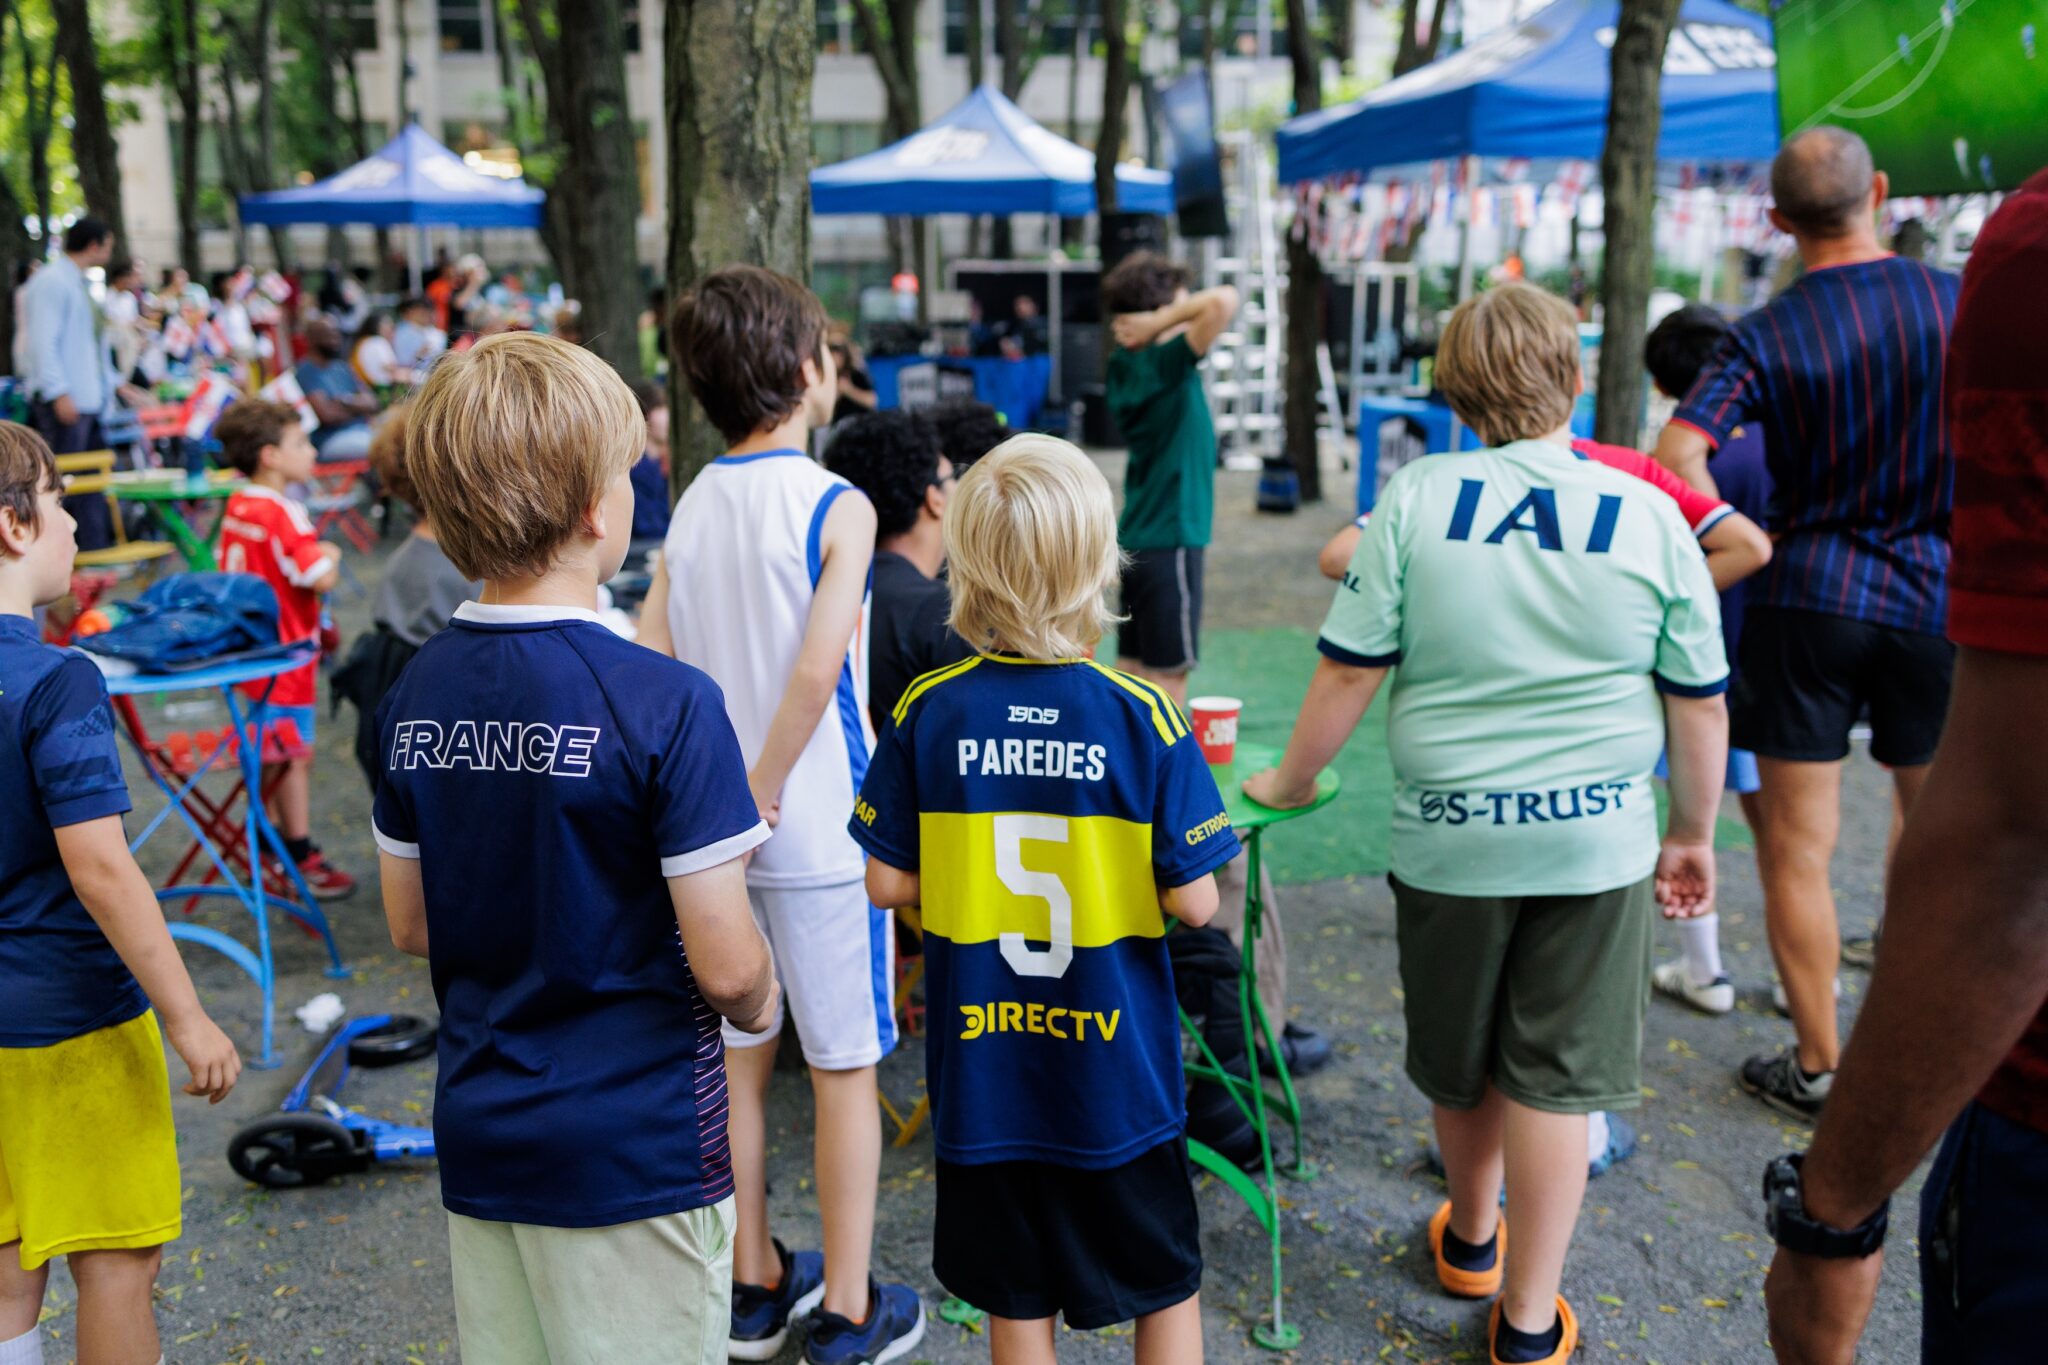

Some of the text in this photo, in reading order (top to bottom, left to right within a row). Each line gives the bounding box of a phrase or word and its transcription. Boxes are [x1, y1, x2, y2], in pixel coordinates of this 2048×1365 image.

[1446, 479, 1623, 553] IAI
[1007, 705, 1060, 725] 1905
[389, 720, 601, 778] FRANCE
[957, 738, 1107, 782] PAREDES
[993, 814, 1074, 979] 5
[959, 1001, 1121, 1042] DIRECTV
